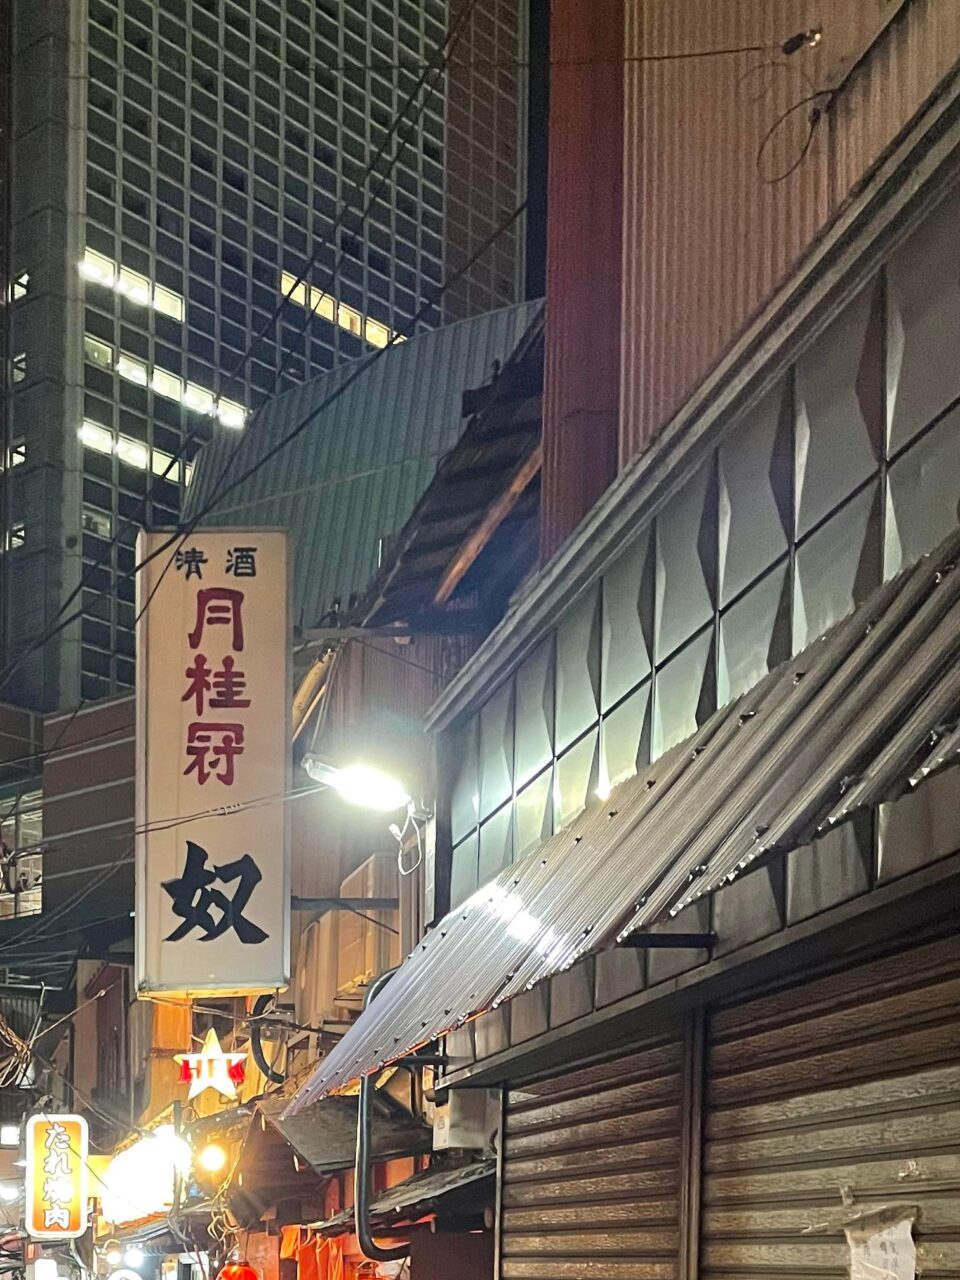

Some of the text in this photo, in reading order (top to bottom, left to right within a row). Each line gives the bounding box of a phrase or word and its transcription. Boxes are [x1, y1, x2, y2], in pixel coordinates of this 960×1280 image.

[181, 587, 251, 786] 月桂冠
[161, 840, 270, 945] 奴
